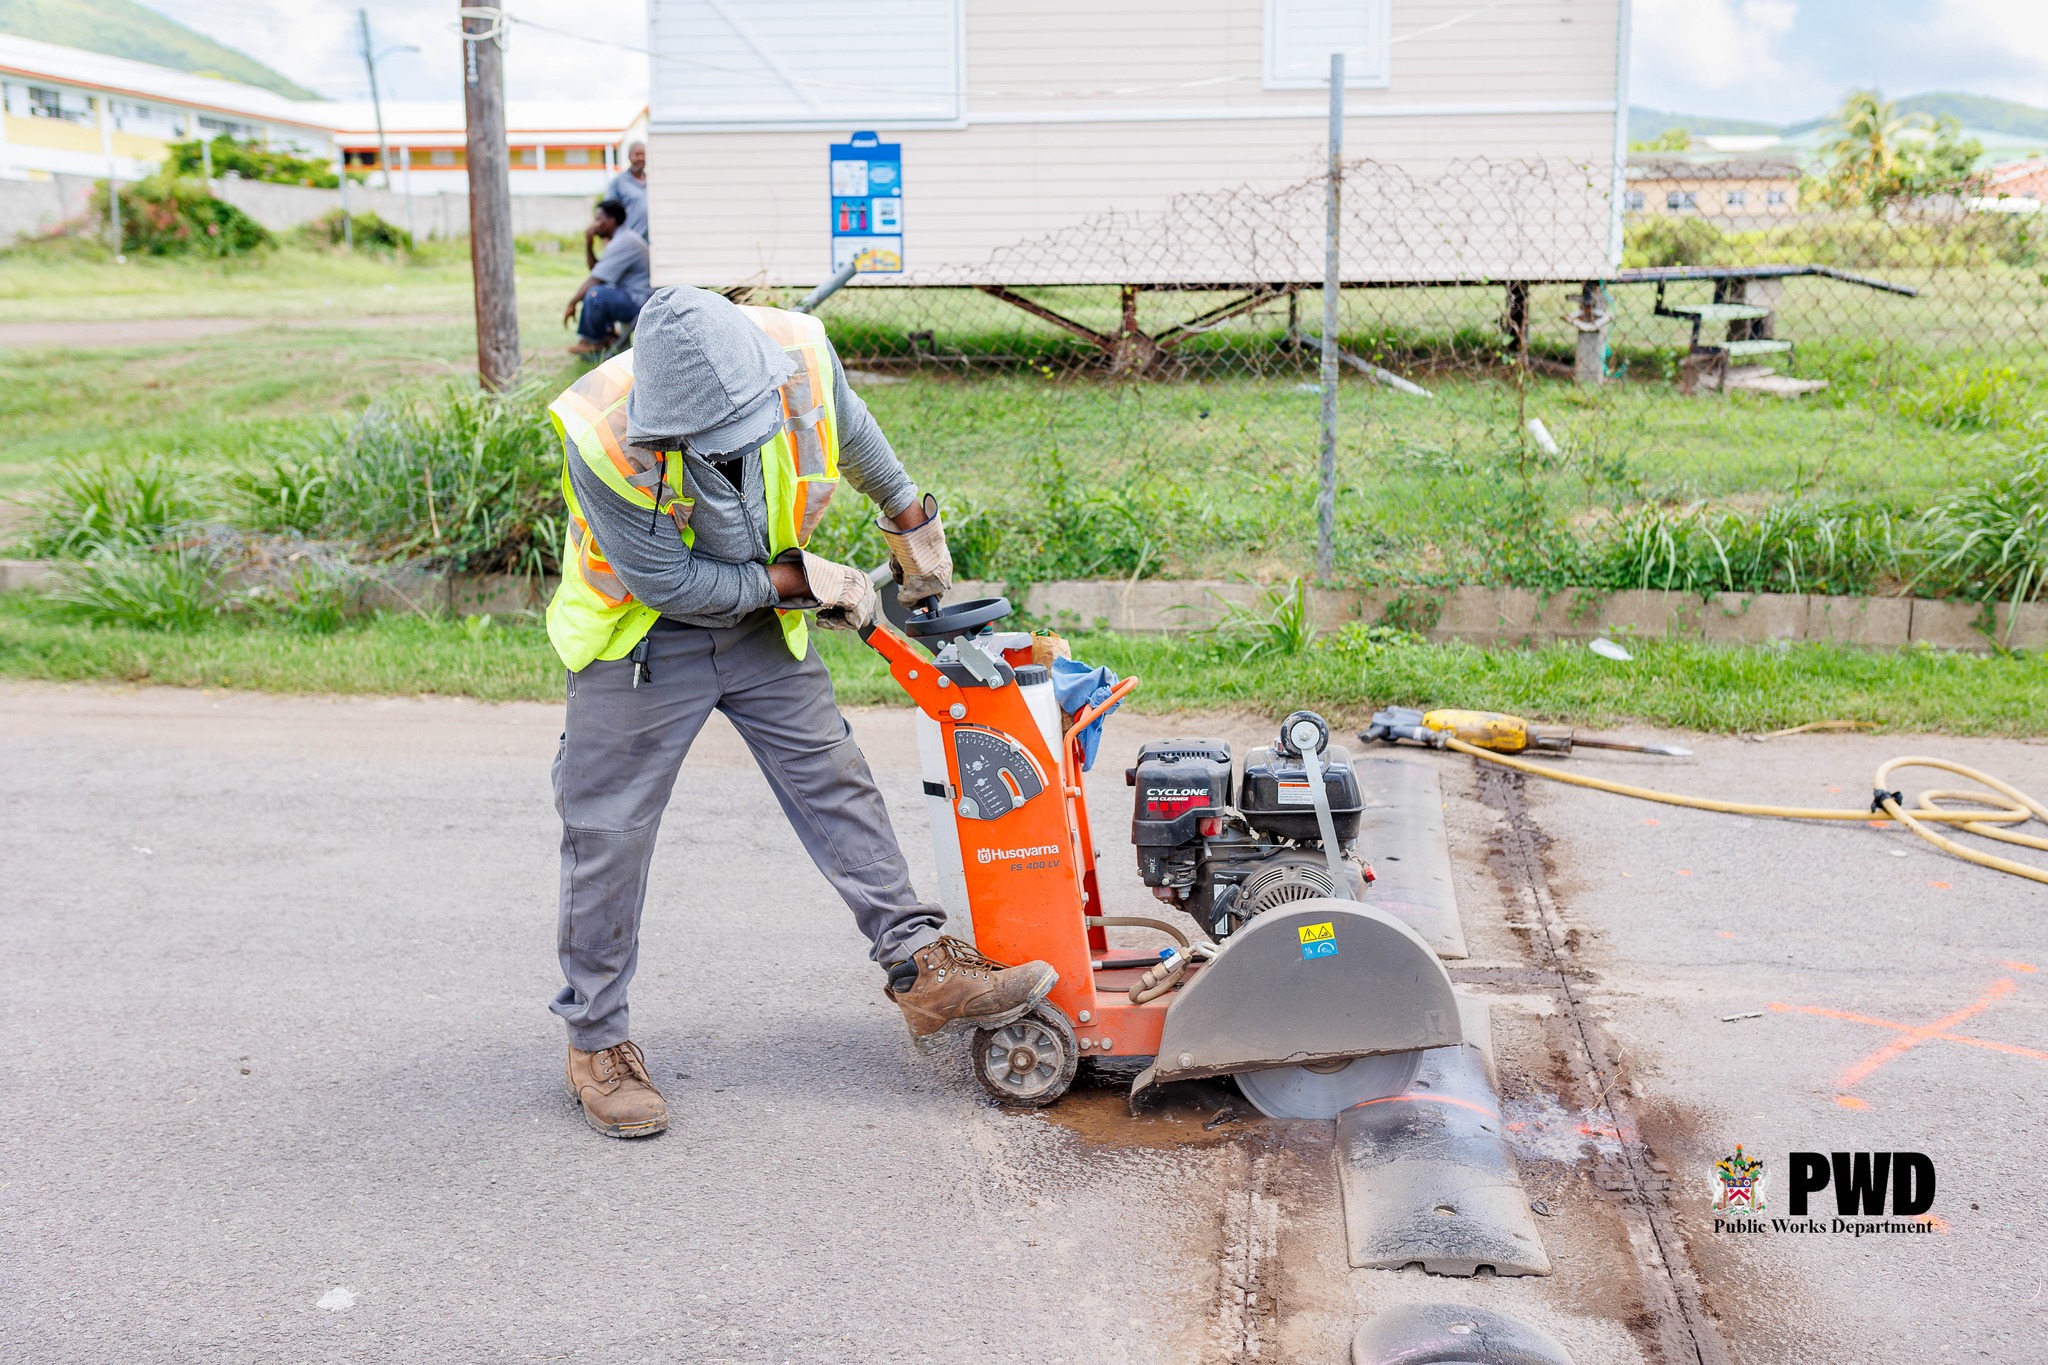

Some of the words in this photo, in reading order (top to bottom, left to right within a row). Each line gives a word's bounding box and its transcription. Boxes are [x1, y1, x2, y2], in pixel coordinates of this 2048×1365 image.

[992, 844, 1060, 860] Husqvarna
[1010, 863, 1023, 872] FS
[1026, 861, 1046, 870] 400
[1048, 859, 1060, 868] LV
